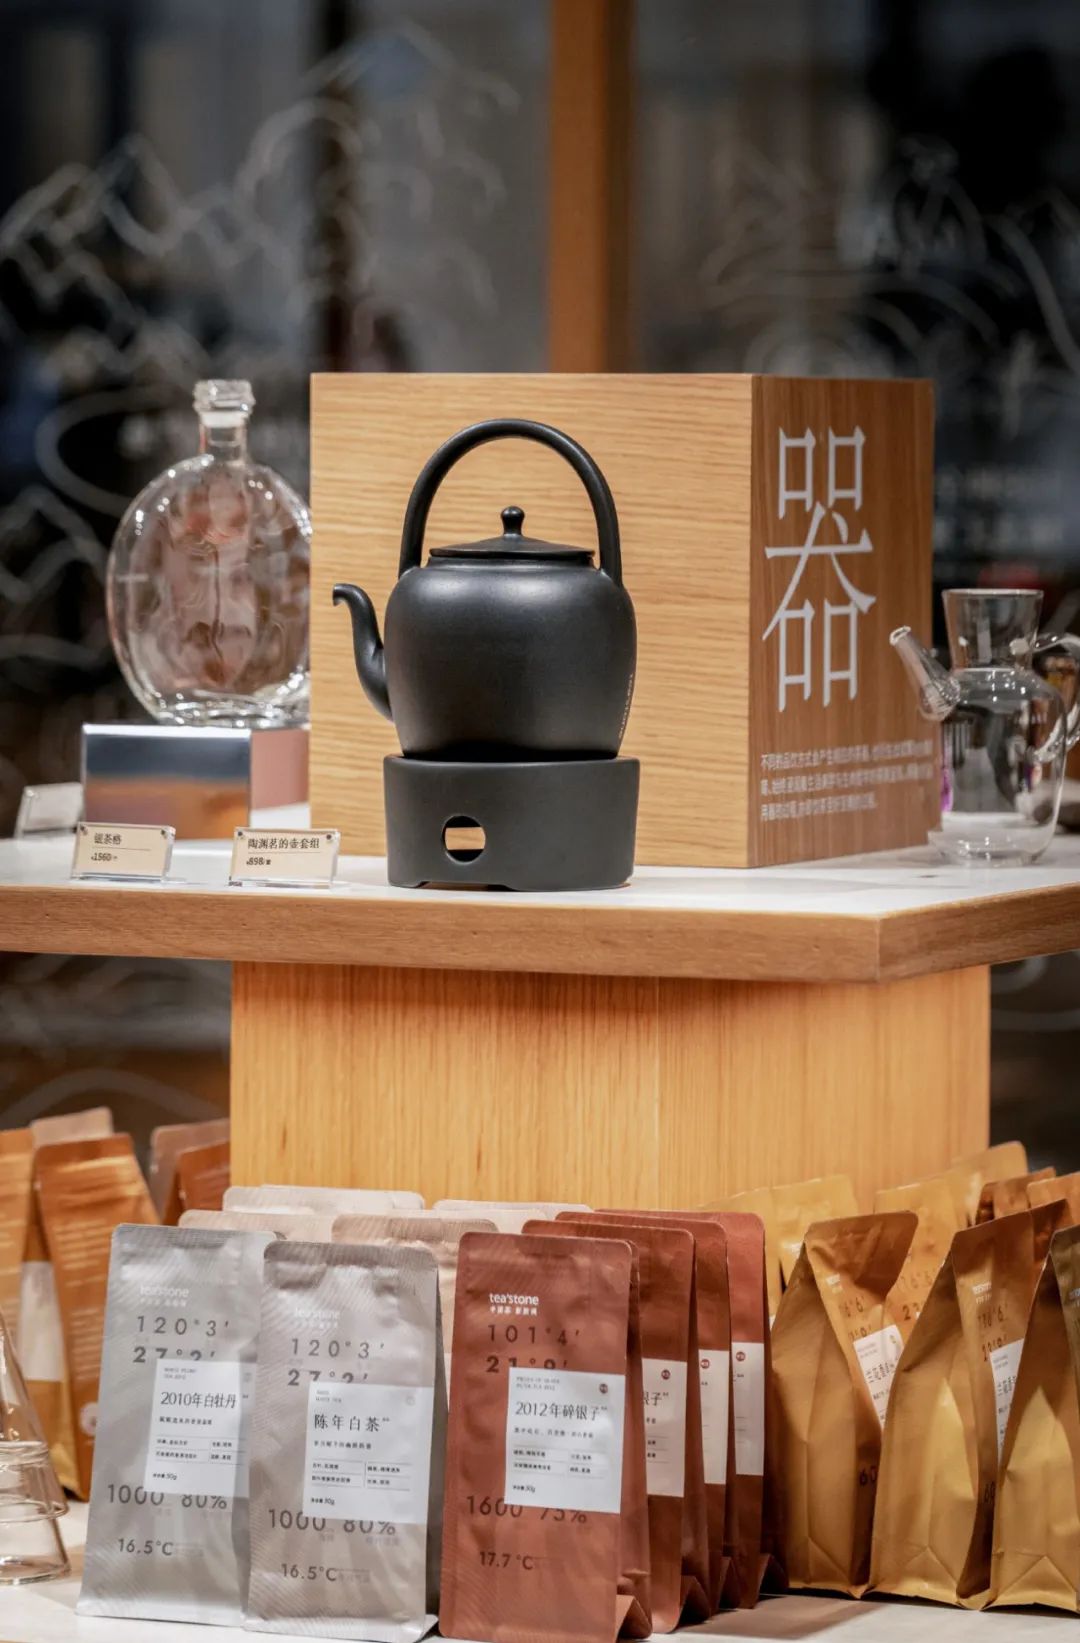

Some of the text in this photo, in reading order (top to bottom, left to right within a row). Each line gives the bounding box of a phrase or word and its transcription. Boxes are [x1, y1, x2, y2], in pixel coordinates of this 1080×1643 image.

[489, 1292, 539, 1305] tea'stone
[160, 1391, 236, 1409] 2010年白牡丹
[515, 1401, 600, 1421] 2012年碎银子
[314, 1413, 380, 1432] 陈年白茶
[118, 1538, 174, 1556] 16.5°C
[281, 1563, 337, 1582] 16.5°C
